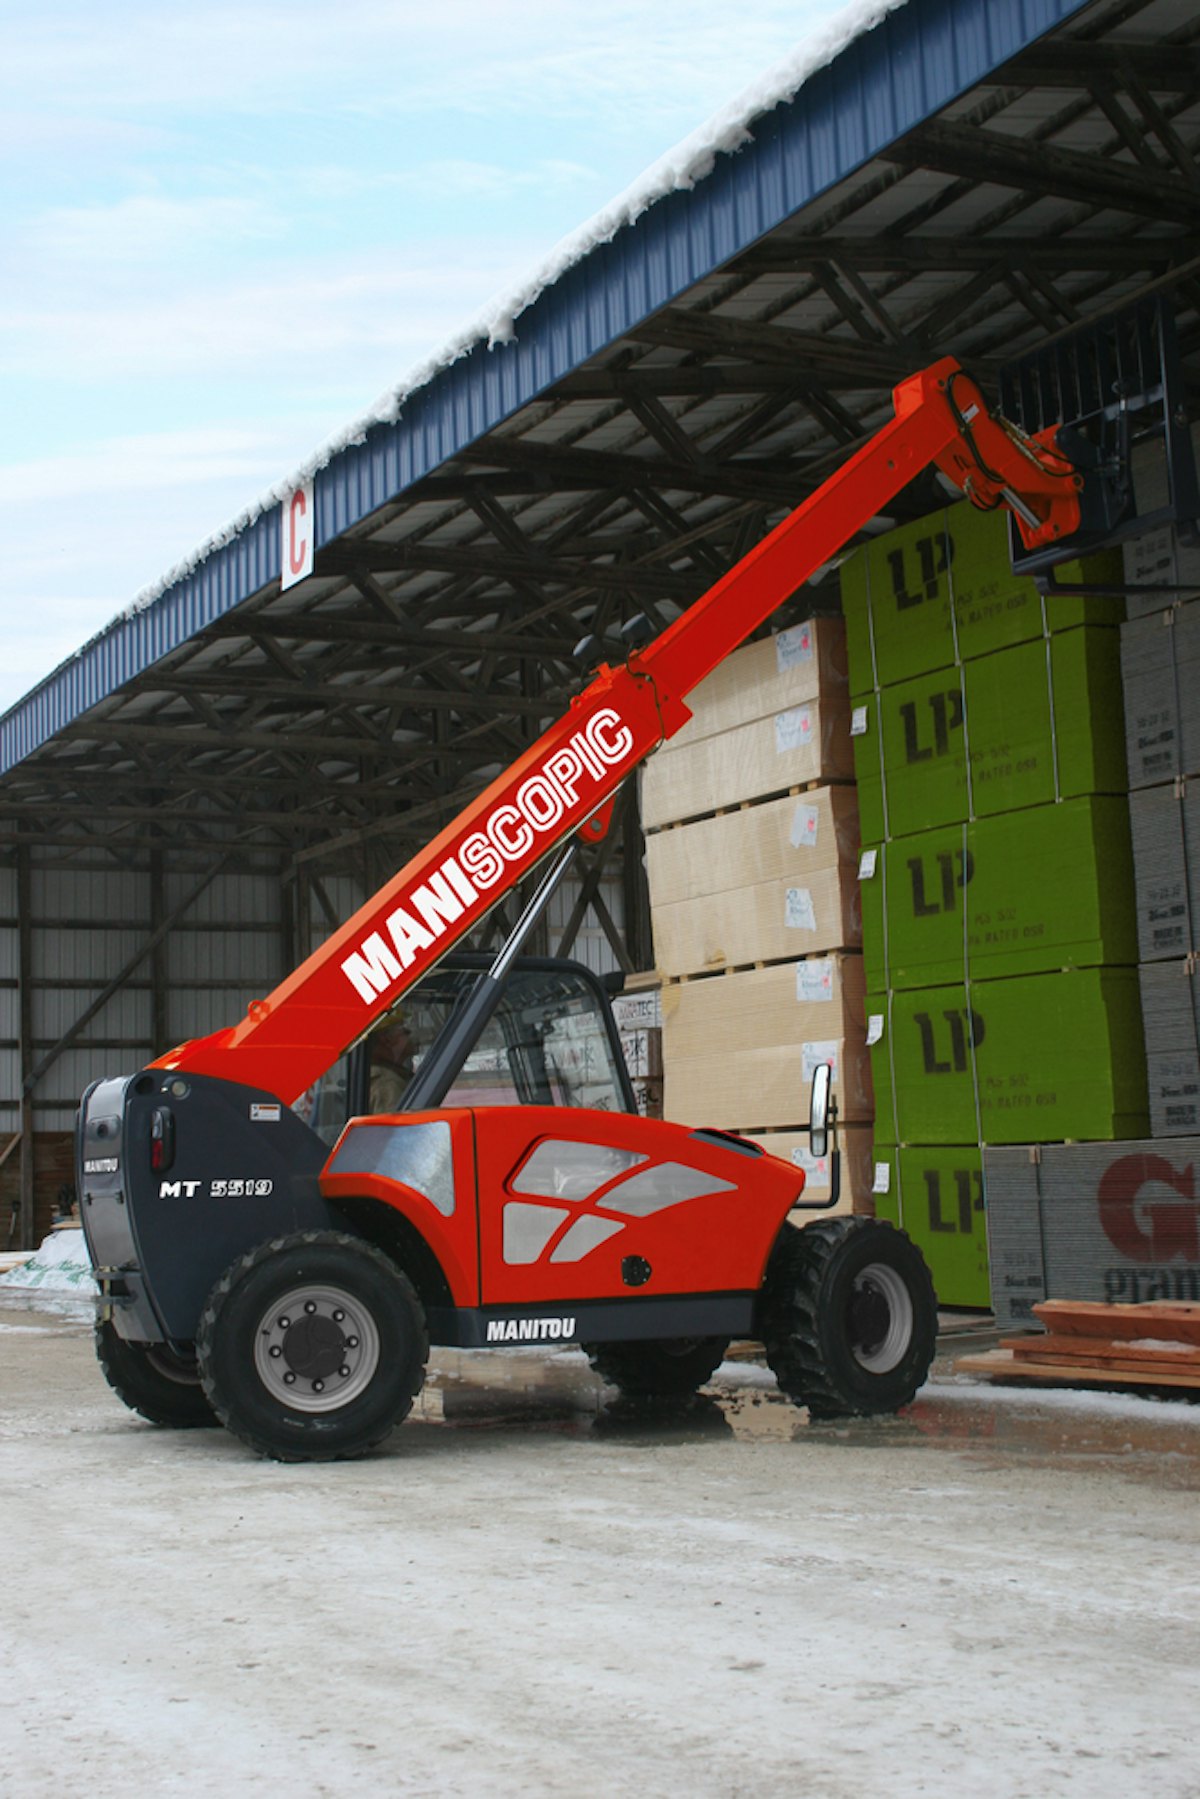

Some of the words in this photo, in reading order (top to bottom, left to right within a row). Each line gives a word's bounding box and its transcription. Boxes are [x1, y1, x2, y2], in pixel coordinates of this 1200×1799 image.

[289, 488, 306, 574] C
[887, 531, 956, 612] LP
[900, 688, 965, 765] LP
[341, 708, 633, 1005] MANISCOPIC
[906, 848, 975, 918] LP
[913, 1008, 986, 1075] LP
[84, 1157, 119, 1173] MANITOU
[159, 1181, 201, 1198] MT
[210, 1179, 273, 1198] 5519
[1096, 1153, 1200, 1264] G
[486, 1317, 576, 1342] MANITOU
